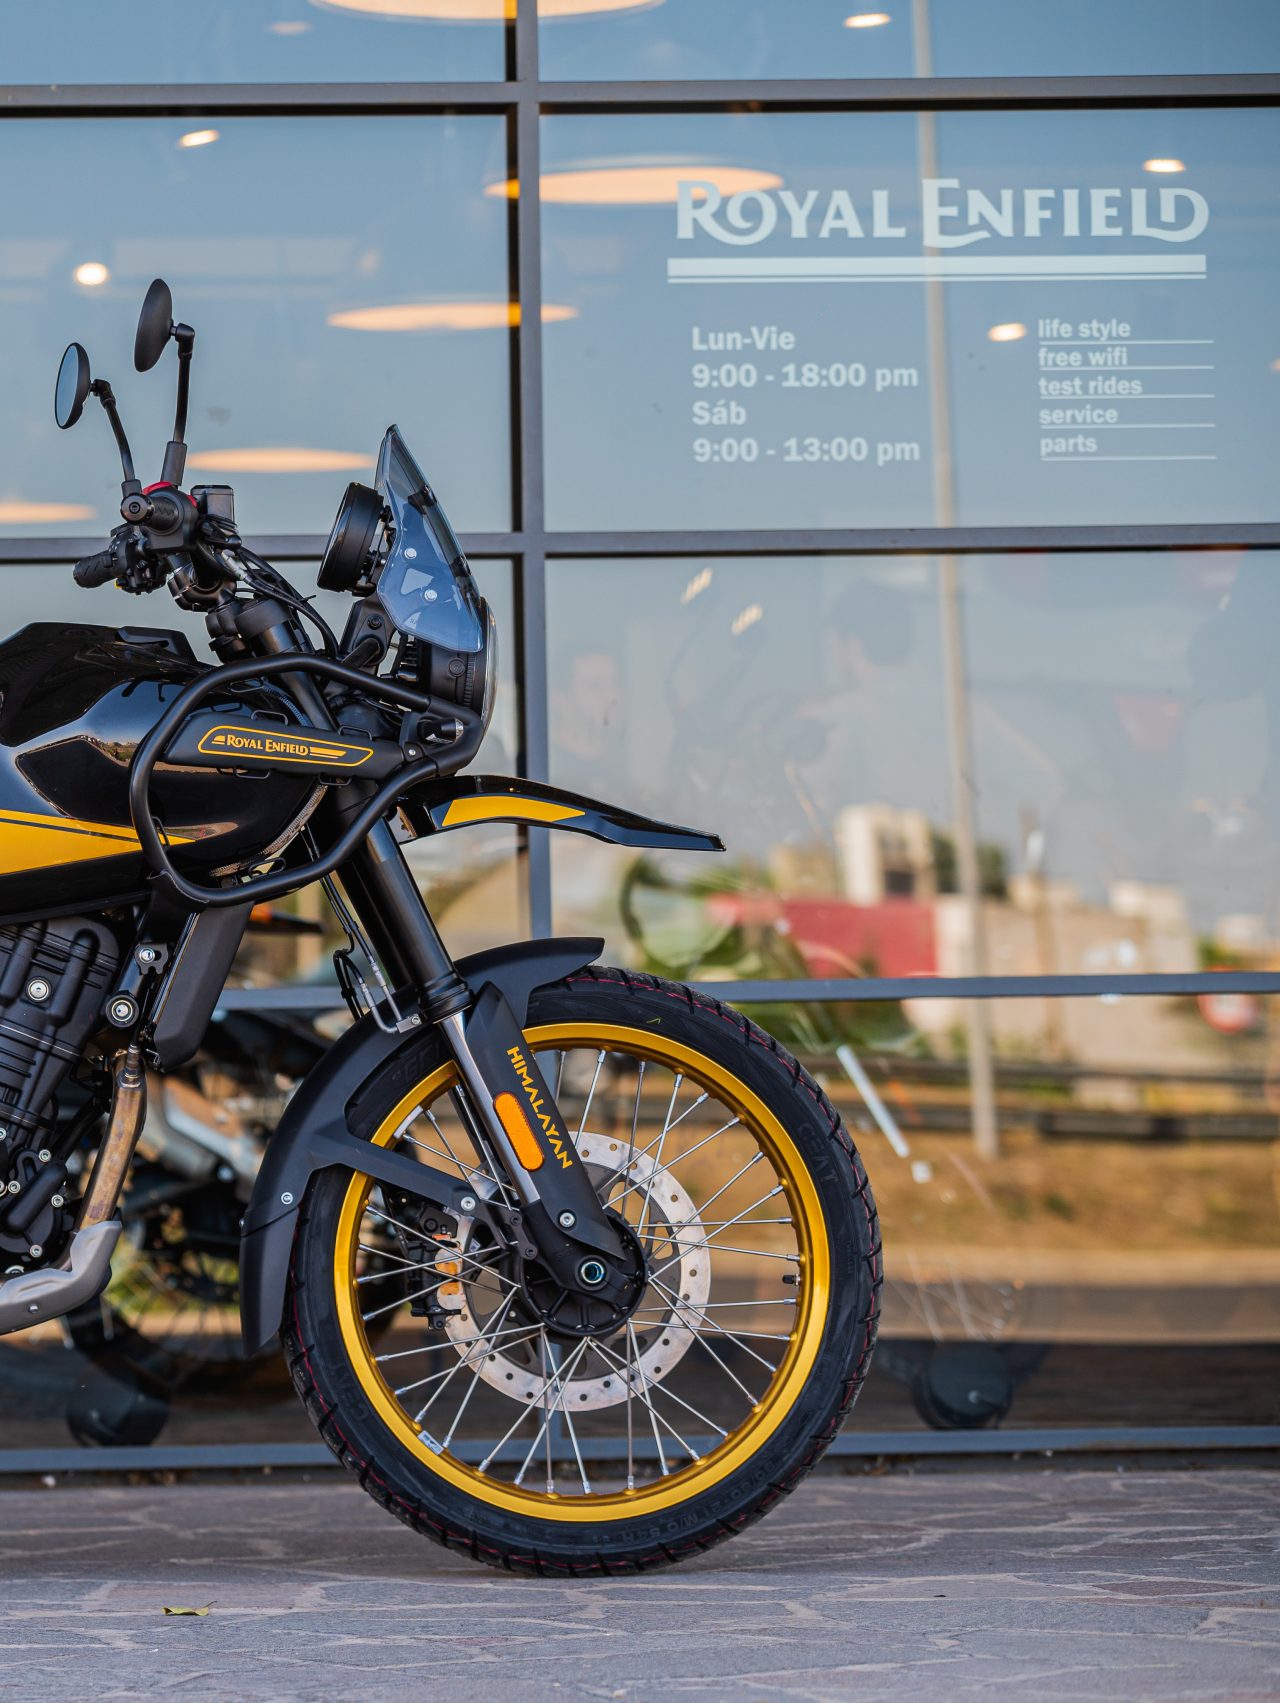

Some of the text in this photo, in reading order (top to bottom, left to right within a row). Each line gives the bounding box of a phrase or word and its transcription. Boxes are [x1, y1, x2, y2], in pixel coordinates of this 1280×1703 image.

[676, 178, 1210, 248] ROYAL ENFIELD
[692, 326, 796, 351] Lun-Vie
[1038, 318, 1131, 342] life style
[1038, 347, 1128, 367] free wifi
[692, 363, 757, 388] 9:00
[781, 362, 867, 388] 18:00
[875, 367, 919, 392] pm
[1038, 376, 1143, 396] test rides
[692, 399, 746, 425] Sáb
[1039, 404, 1119, 424] service
[693, 437, 758, 463] 9:00
[783, 436, 868, 462] 13:00
[877, 441, 920, 466] pm
[1040, 434, 1098, 457] parts
[226, 734, 308, 756] ROYAL ENFIELD
[506, 1046, 573, 1169] HIMALAYAN
